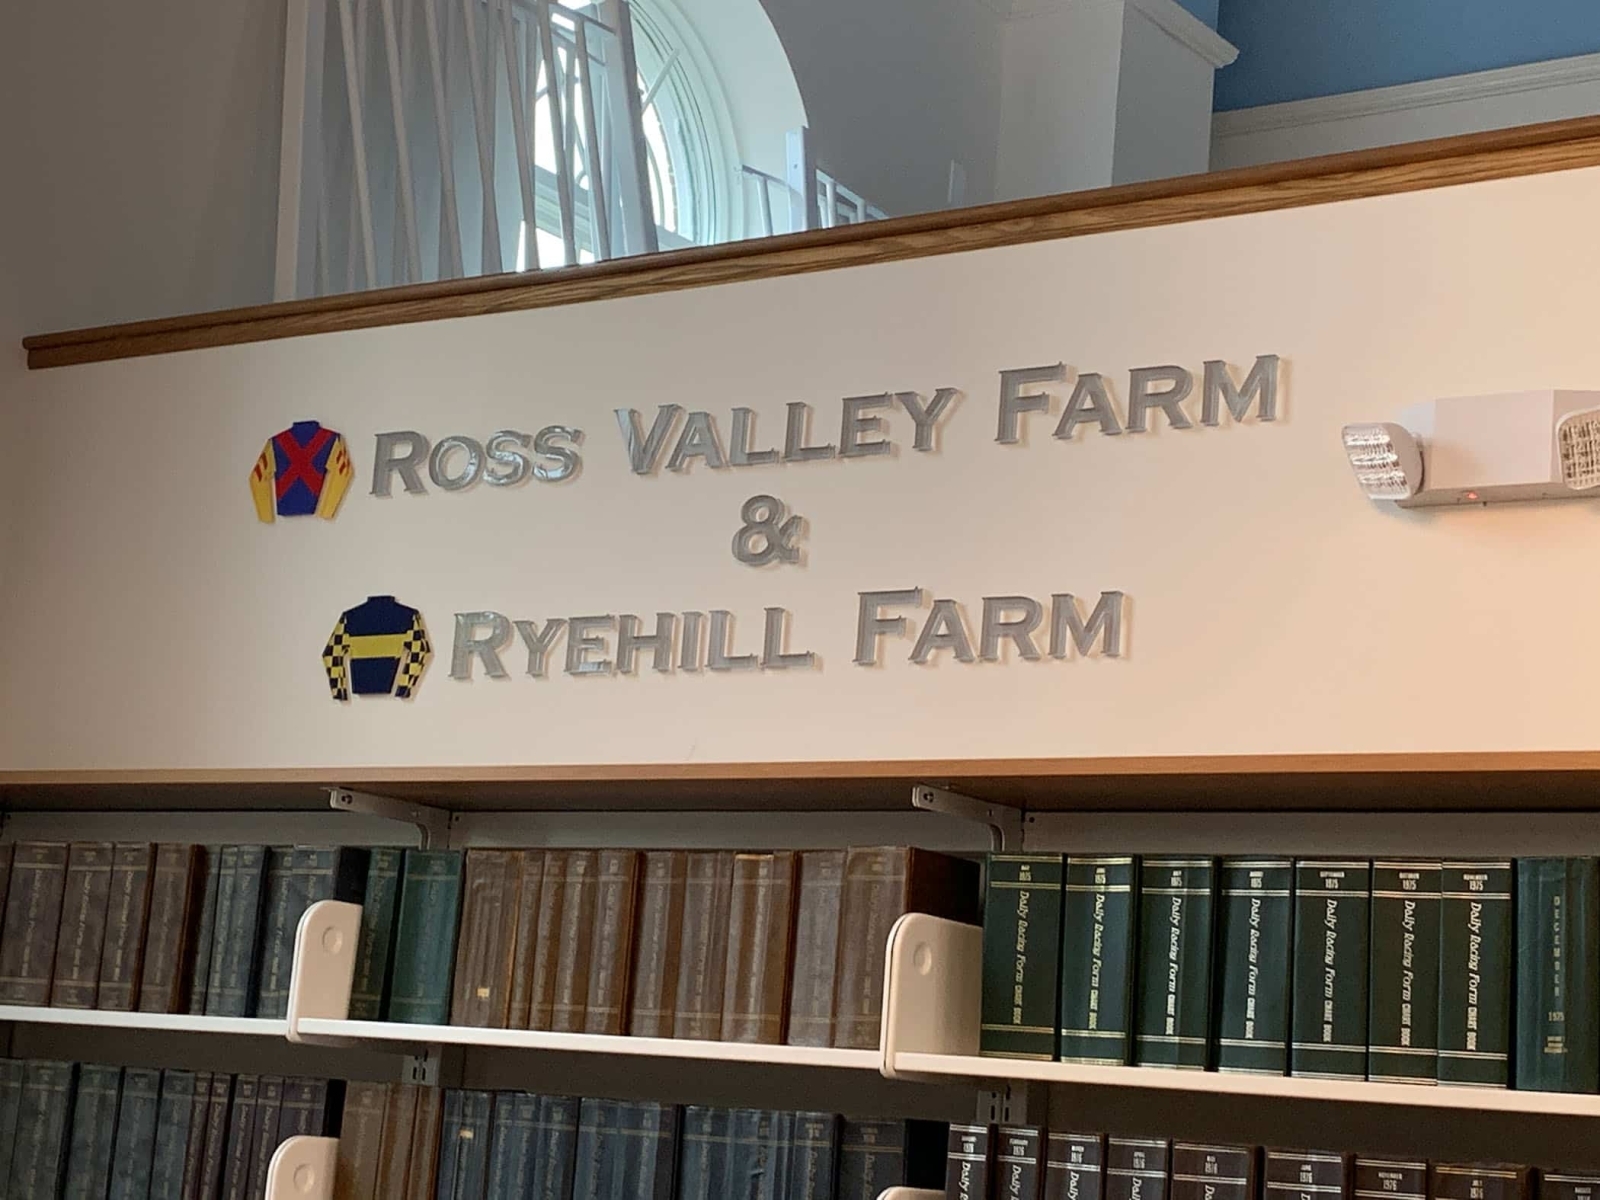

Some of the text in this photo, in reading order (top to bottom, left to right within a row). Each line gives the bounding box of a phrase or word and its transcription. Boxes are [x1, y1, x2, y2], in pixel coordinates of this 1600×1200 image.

[368, 354, 1283, 497] ROSS VALLEY FARM
[731, 494, 804, 567] &
[447, 586, 1128, 681] RYEHILL FARM
[1402, 879, 1417, 890] 1975
[1469, 880, 1484, 891] 1975
[1016, 890, 1030, 919] Daily
[1093, 893, 1106, 923] Daily
[1169, 896, 1182, 926] Daily
[1248, 898, 1261, 928] Daily
[1324, 898, 1338, 930] Daily
[1401, 900, 1416, 932] Daily
[1467, 900, 1482, 934] Daily
[1016, 919, 1029, 953] Racing
[1092, 922, 1104, 957] Racing
[1168, 926, 1181, 961] Racing
[1248, 928, 1260, 964] Racing
[1324, 930, 1337, 966] Racing
[1402, 932, 1415, 968] Racing
[1015, 953, 1027, 983] Form
[1468, 934, 1482, 971] Racing
[1091, 957, 1102, 988] Form
[1168, 962, 1179, 993] Form
[1248, 964, 1259, 996] Form
[1324, 967, 1336, 998] Form
[1402, 969, 1414, 1002] Form
[1468, 972, 1481, 1005] Form
[958, 1160, 971, 1192] Daily
[1008, 1164, 1022, 1196] Daily
[1129, 1177, 1143, 1200] Dail
